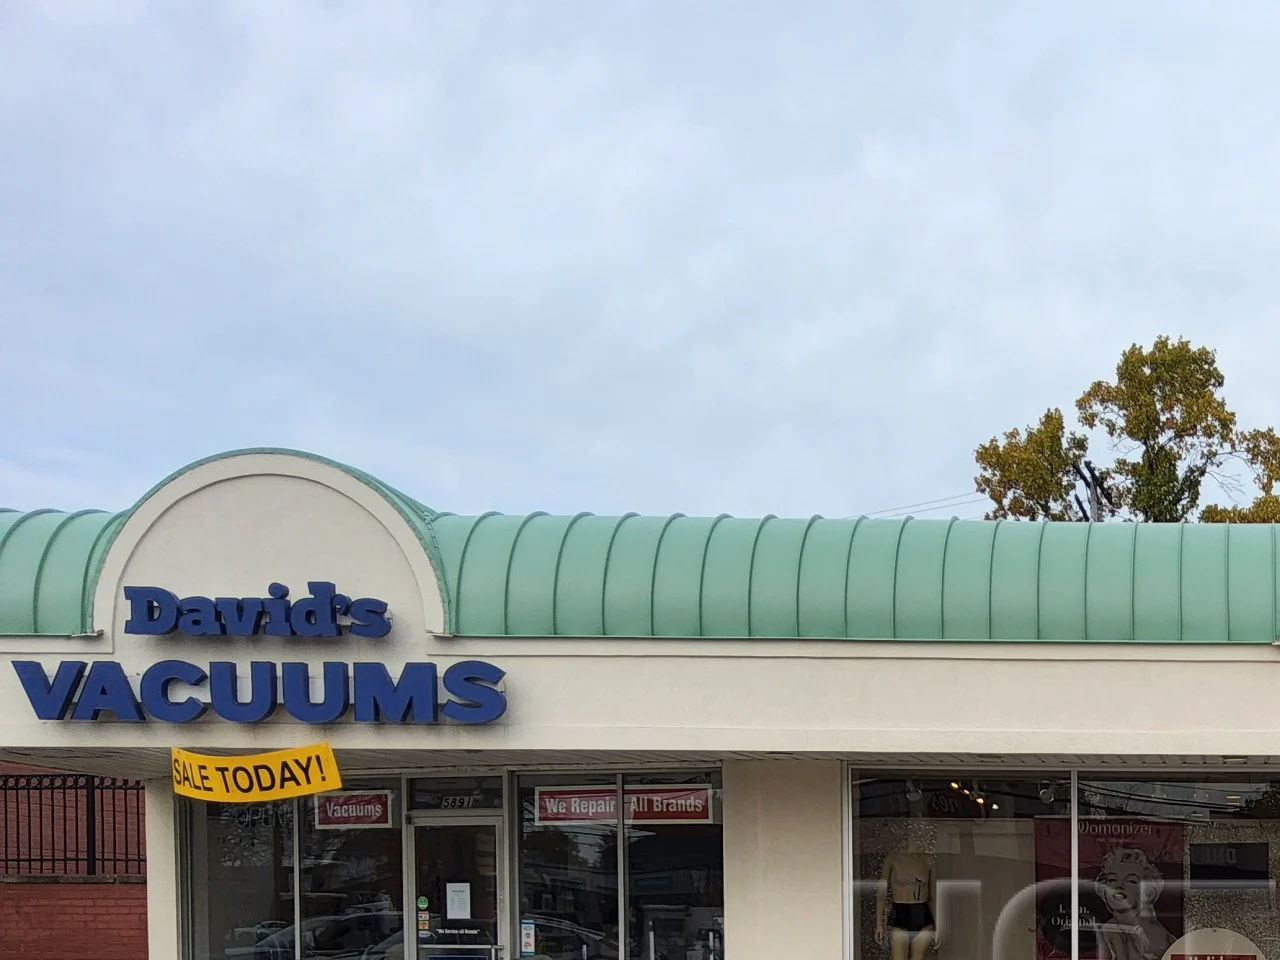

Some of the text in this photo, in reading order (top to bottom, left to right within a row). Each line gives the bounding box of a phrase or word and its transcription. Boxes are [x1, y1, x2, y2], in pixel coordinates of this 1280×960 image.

[124, 582, 392, 638] David's
[11, 660, 508, 725] VACUUMS
[174, 754, 327, 794] SALE TODAY!
[326, 803, 383, 817] Vacuums
[442, 797, 472, 808] 5891
[545, 796, 703, 816] We Repair All Brands
[1051, 915, 1096, 927] Orinal
